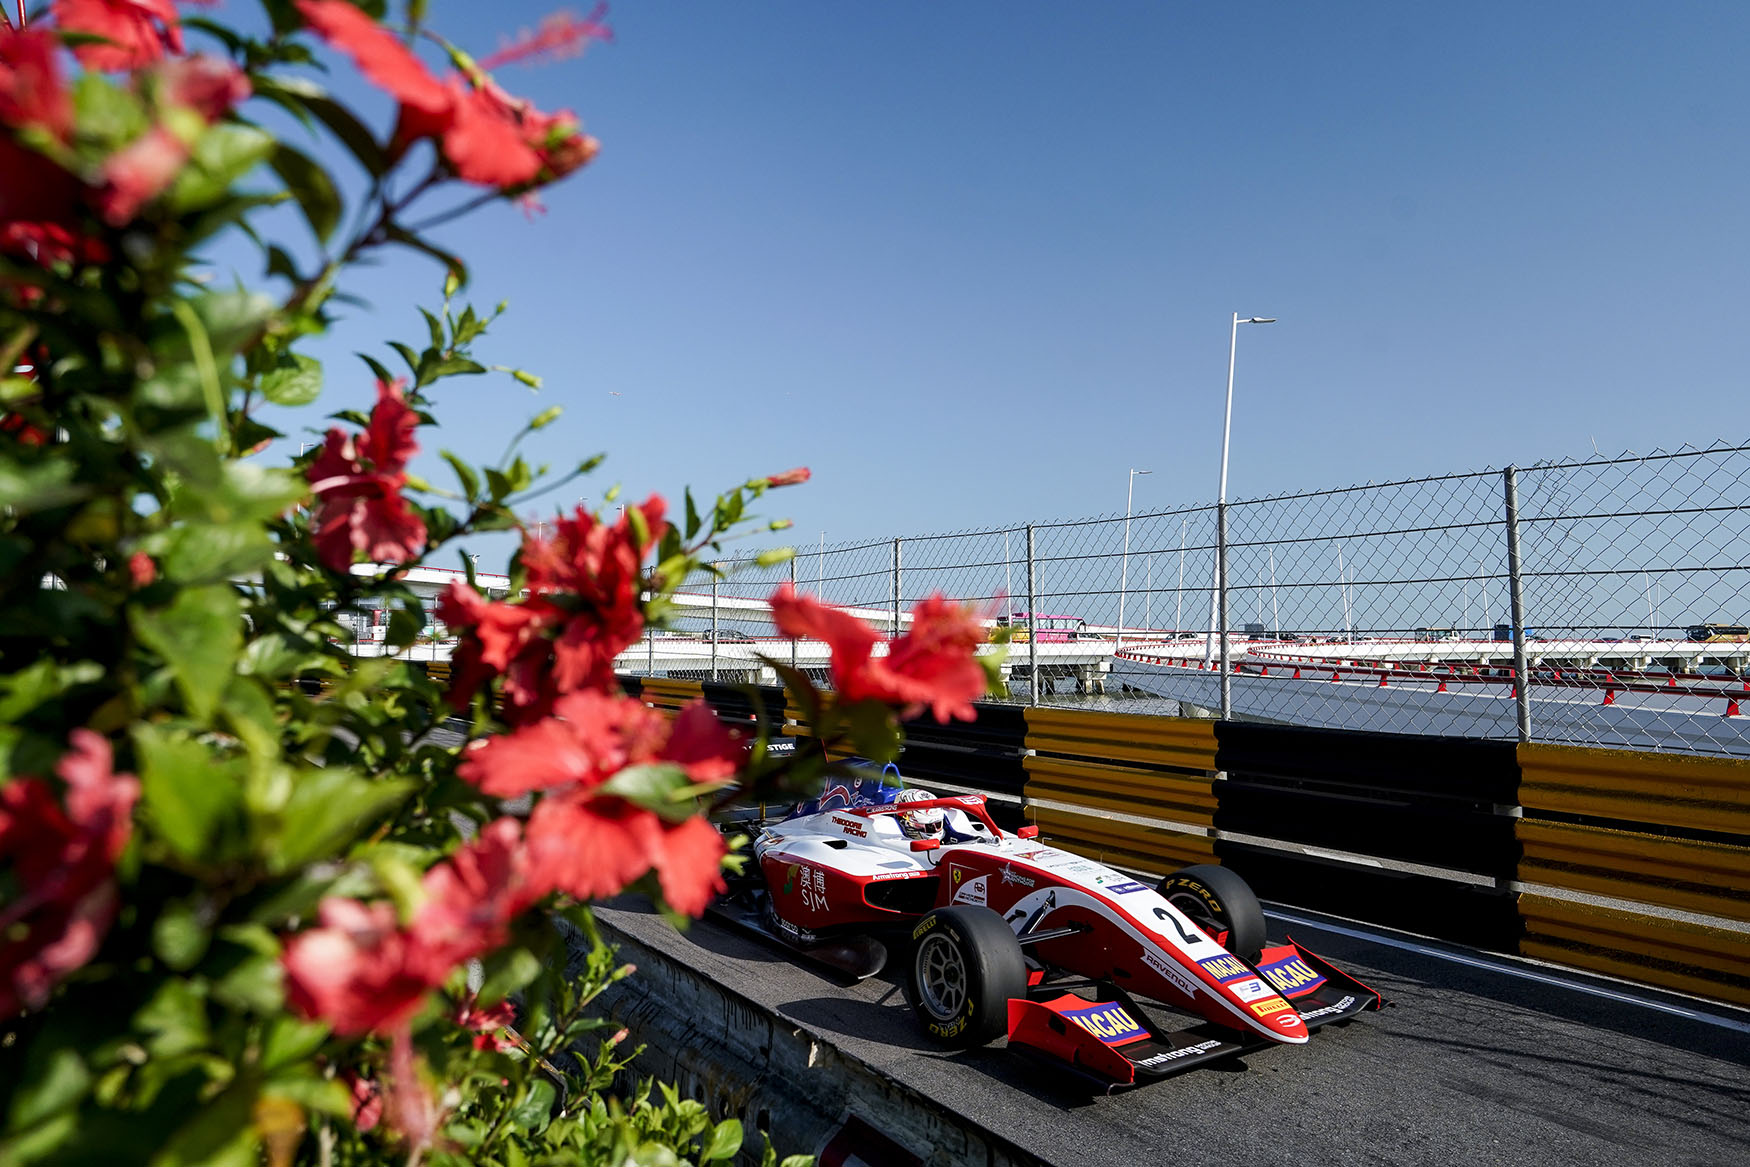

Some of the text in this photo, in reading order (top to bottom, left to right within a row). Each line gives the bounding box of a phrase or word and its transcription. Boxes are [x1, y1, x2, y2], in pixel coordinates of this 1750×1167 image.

[831, 816, 863, 830] THEODORE
[843, 827, 868, 838] RACING
[800, 865, 826, 894] 澳博
[872, 872, 910, 881] Armstrong
[801, 889, 830, 912] SJM
[1166, 878, 1222, 912] P ZERO
[912, 914, 937, 940] PIRELLI
[1153, 907, 1203, 944] 2
[1146, 954, 1191, 993] RAVENOL
[1201, 956, 1250, 980] MACAU
[967, 997, 974, 1017] P
[1256, 1000, 1288, 1013] PIRELLI
[929, 1015, 968, 1038] ZERO
